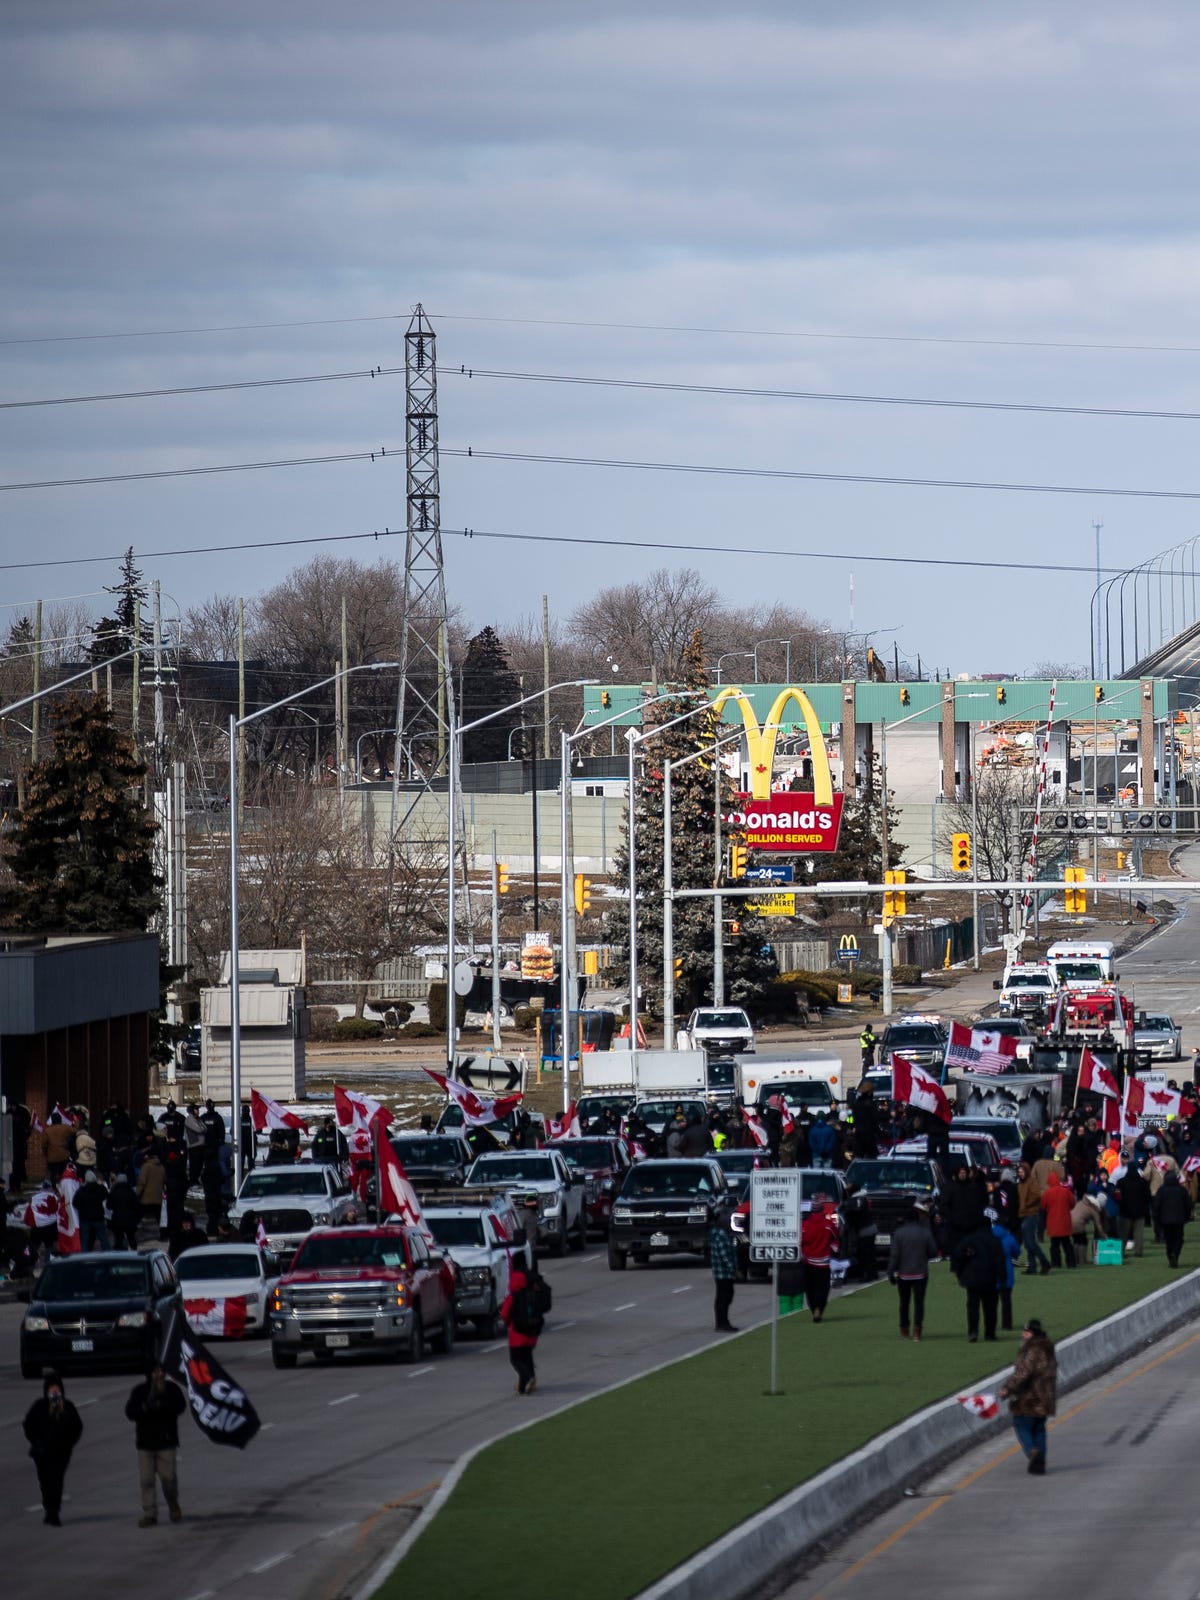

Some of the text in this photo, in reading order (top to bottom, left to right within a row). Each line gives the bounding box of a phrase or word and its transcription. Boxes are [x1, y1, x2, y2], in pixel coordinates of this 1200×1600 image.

[714, 810, 832, 829] Donald's
[747, 833, 784, 843] BILLION
[785, 834, 823, 843] SERVED
[759, 868, 772, 879] 24
[754, 1176, 797, 1186] COMMUNITY
[762, 1189, 789, 1199] SAFETY
[765, 1203, 785, 1212] ZONE
[765, 1218, 786, 1227] FINES
[753, 1231, 797, 1240] INCREASED
[755, 1247, 795, 1260] ENDS
